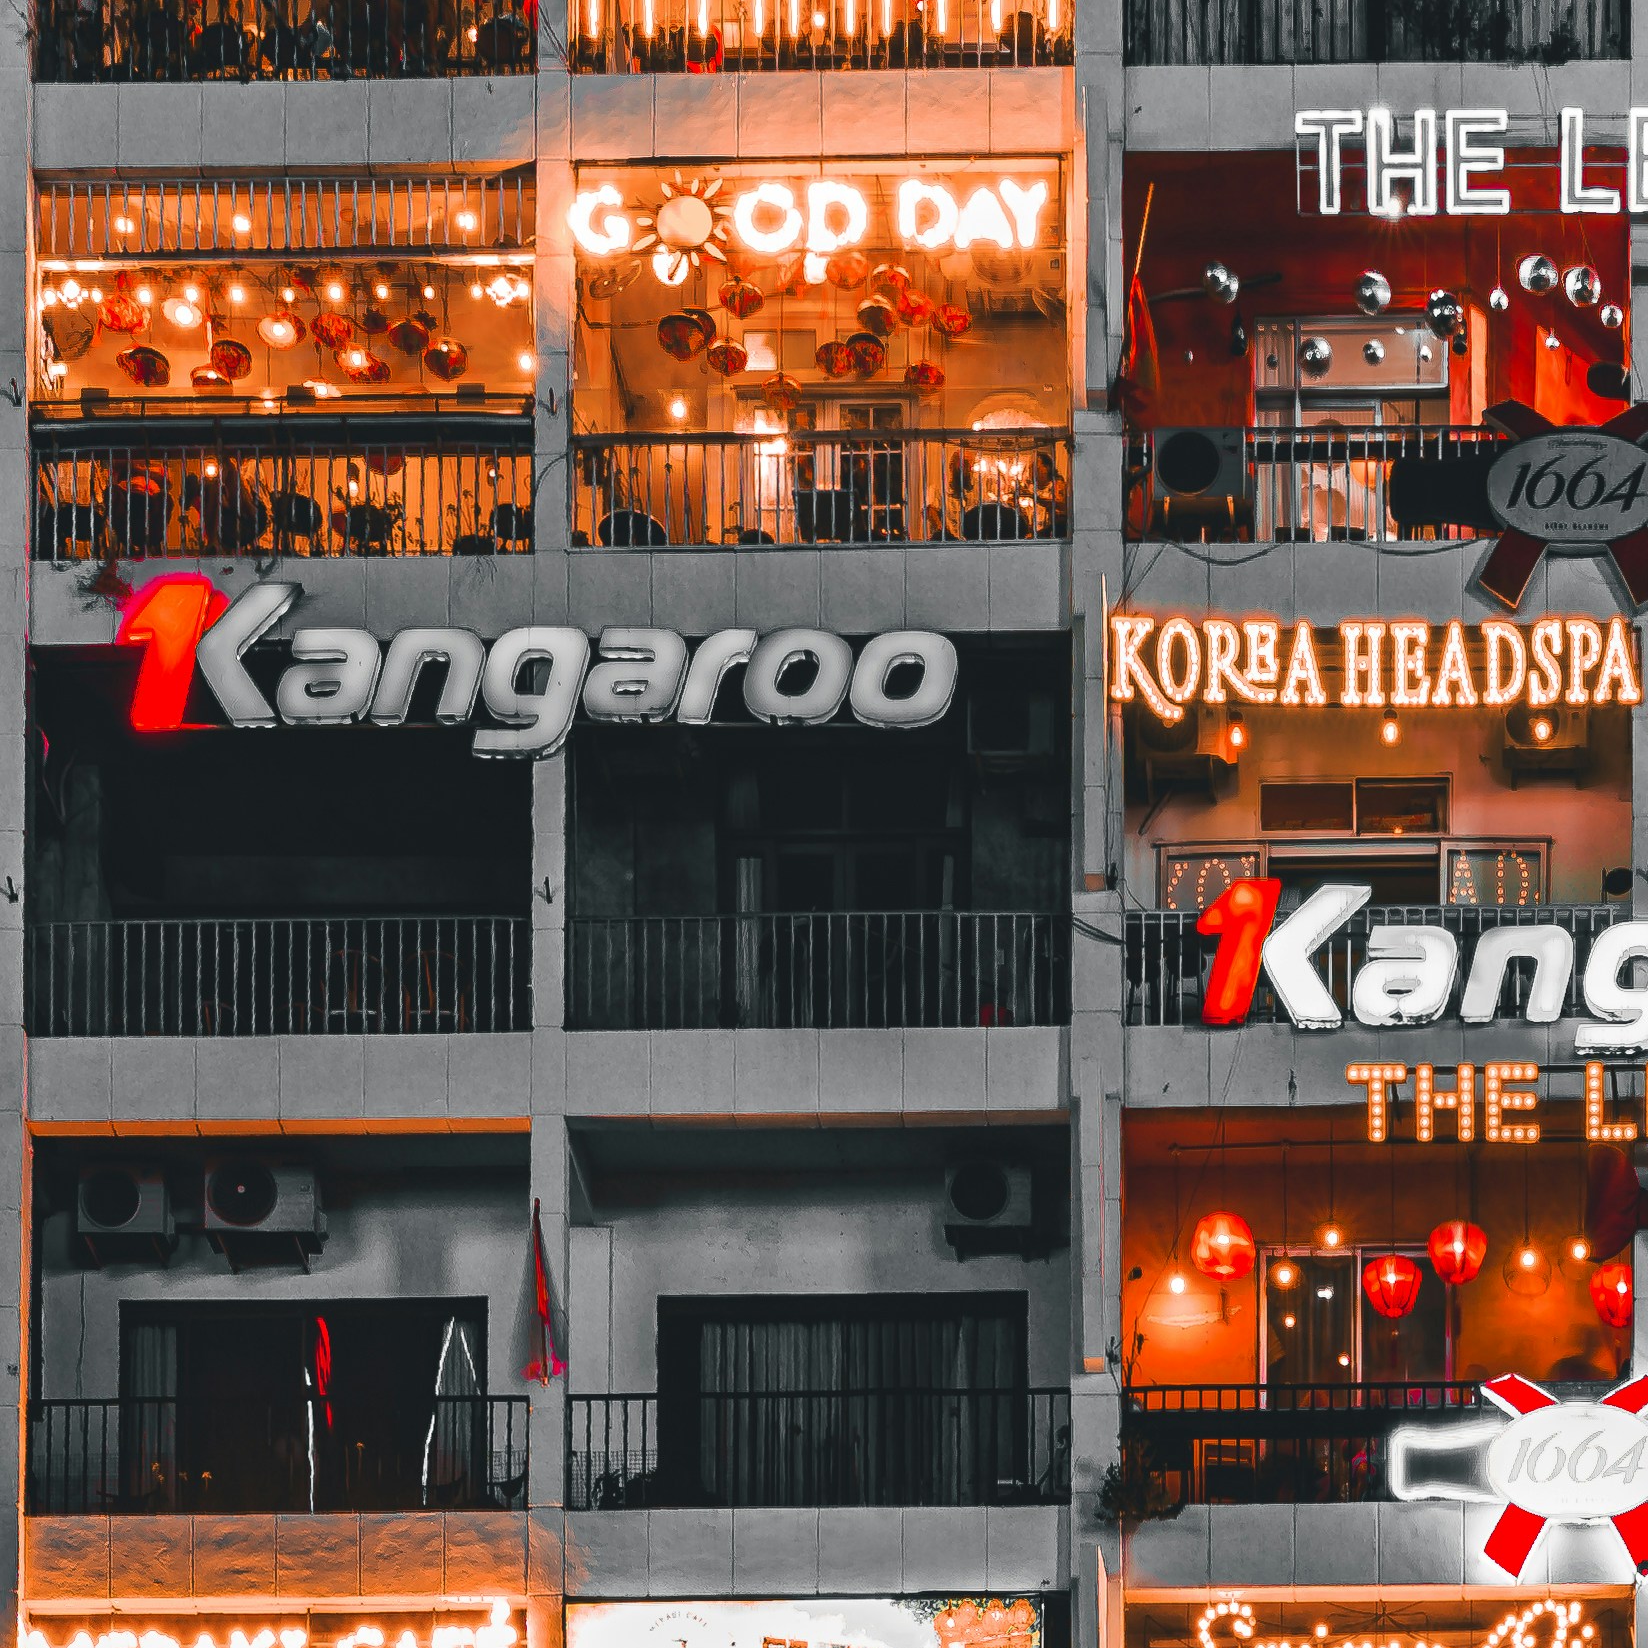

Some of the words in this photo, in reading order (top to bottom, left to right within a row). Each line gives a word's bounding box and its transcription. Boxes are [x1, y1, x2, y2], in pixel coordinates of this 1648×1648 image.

[1295, 107, 1510, 216] THE
[896, 178, 1051, 251] DAY
[1110, 616, 1327, 722] KOREA
[1344, 1060, 1542, 1144] THE
